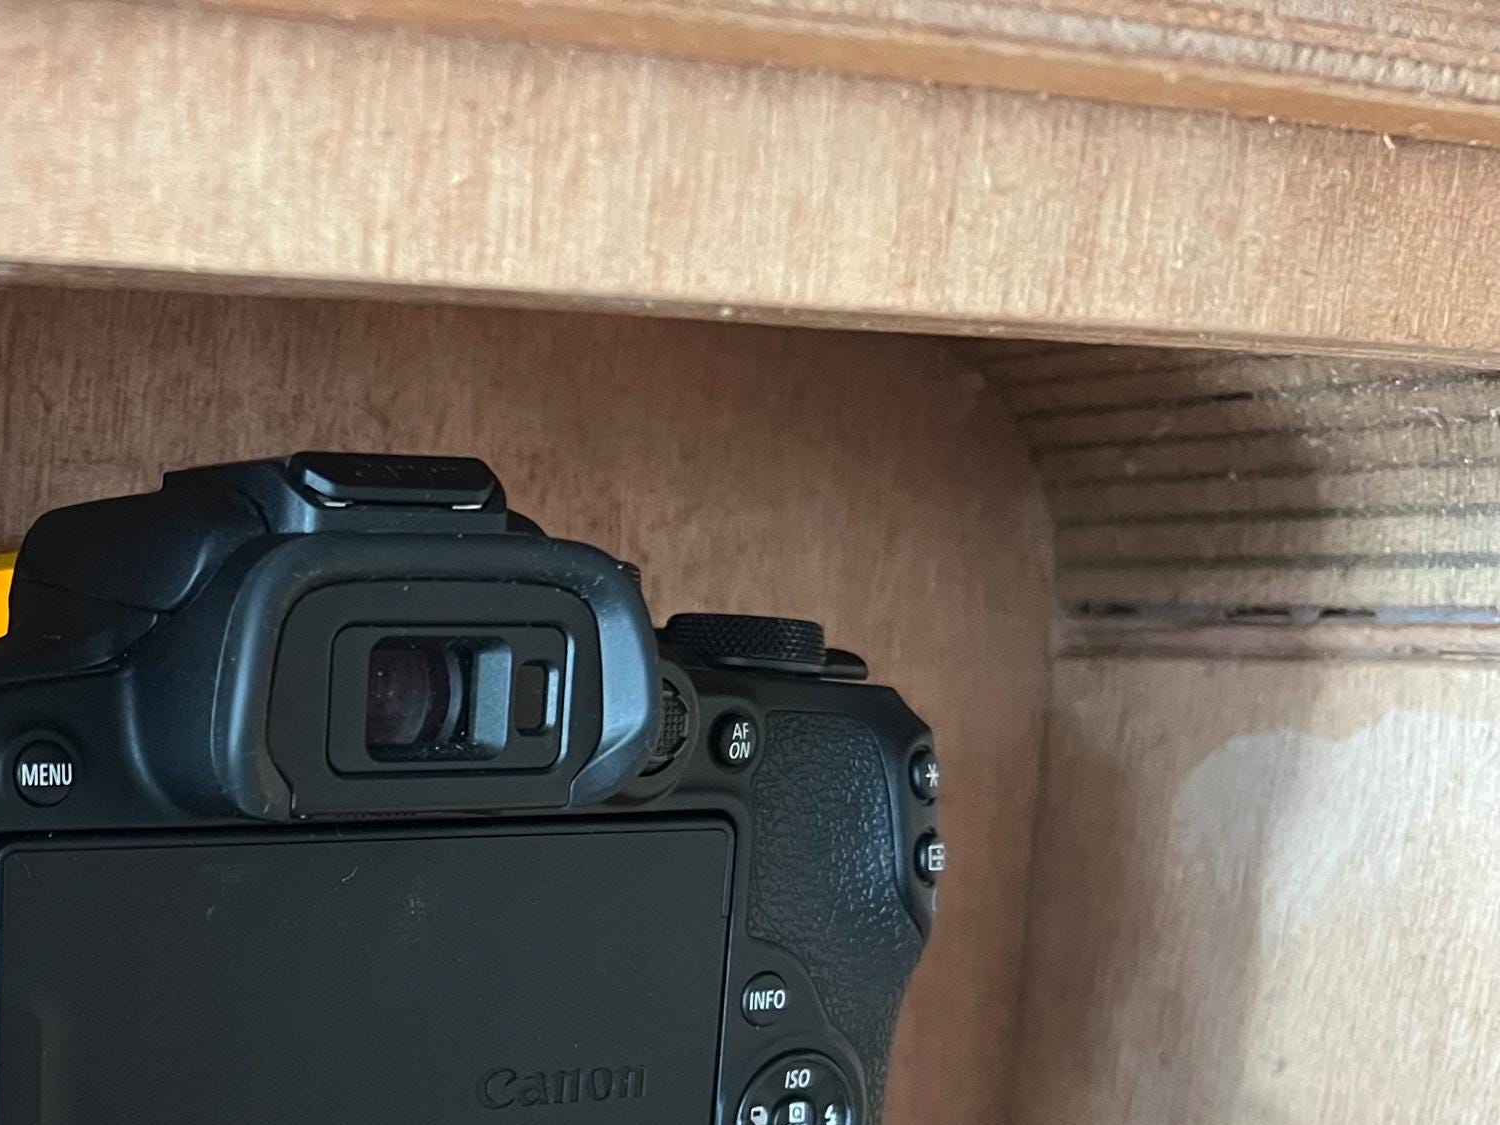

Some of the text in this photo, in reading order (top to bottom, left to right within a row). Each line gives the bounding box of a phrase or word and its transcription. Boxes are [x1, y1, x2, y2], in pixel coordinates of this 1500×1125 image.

[732, 723, 749, 740] AF
[729, 742, 750, 759] ON
[21, 763, 73, 786] MENU
[750, 990, 786, 1010] INFO
[477, 1064, 647, 1110] Canon
[785, 1069, 811, 1089] ISO
